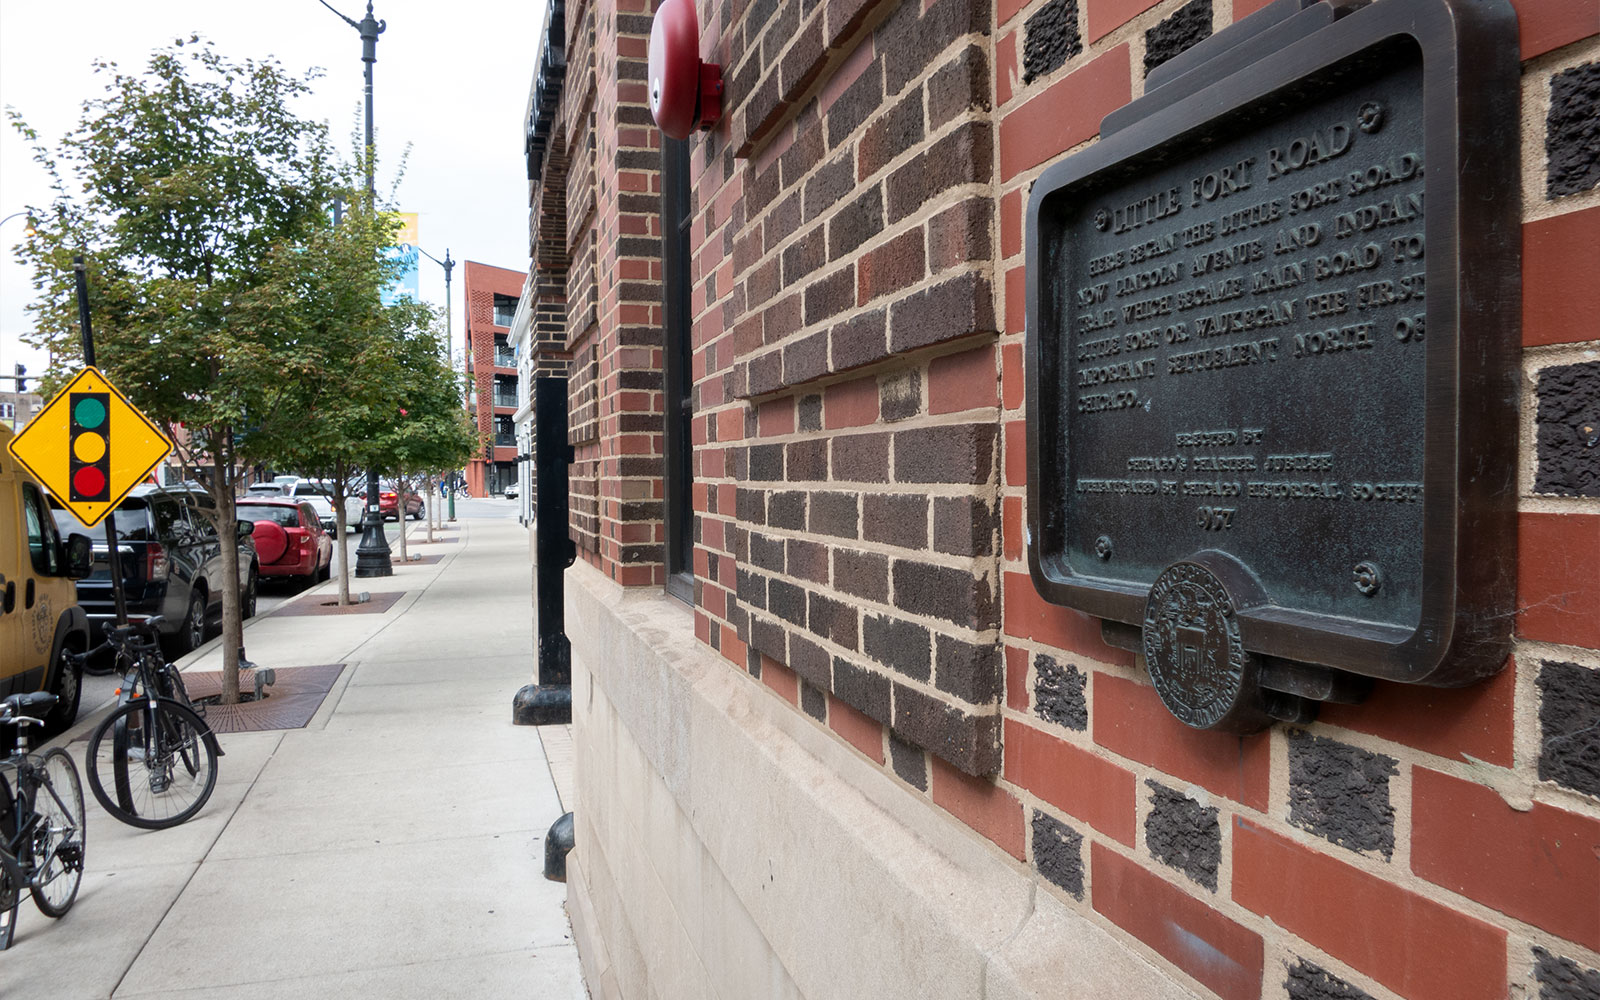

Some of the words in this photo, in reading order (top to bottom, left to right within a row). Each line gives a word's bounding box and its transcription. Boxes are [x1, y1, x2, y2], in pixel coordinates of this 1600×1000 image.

[1113, 187, 1182, 234] LITTLE
[1191, 157, 1256, 207] FORT
[1266, 122, 1350, 181] ROAD
[1077, 281, 1109, 307] NOW
[1116, 261, 1184, 297] LINCOLN
[1191, 237, 1264, 278] AVENUE
[1273, 223, 1321, 256] AND
[1335, 190, 1424, 240] INDIAN
[1089, 250, 1125, 277] HERE
[1129, 232, 1182, 264] BEGAN
[1182, 221, 1216, 248] THE
[1220, 199, 1282, 235] LITTLE
[1289, 177, 1342, 215] FORT
[1077, 335, 1121, 361] LITTLE
[1124, 327, 1161, 352] FORT
[1164, 322, 1190, 345] OR
[1195, 299, 1298, 339] WAUKEGAN
[1305, 290, 1349, 319] THE
[1356, 272, 1425, 310] FIRST
[1078, 308, 1116, 333] TRAIL
[1121, 293, 1173, 324] WHICH
[1176, 276, 1246, 311] BECAME
[1251, 258, 1309, 295] MAIN
[1315, 241, 1382, 281] ROAD
[1390, 233, 1424, 263] TO
[1077, 357, 1156, 387] IMPORTANT
[1167, 338, 1280, 374] SETTLEMENT
[1293, 321, 1376, 358] NORTH
[1077, 389, 1142, 414] CHICAGO.
[1176, 430, 1238, 447] ERECTED
[1242, 428, 1264, 445] BY
[1127, 453, 1187, 472] CHICAGO'S
[1193, 455, 1256, 472] CHARTER
[1264, 453, 1334, 472] JUBILEE
[1161, 480, 1179, 496] BY
[1183, 481, 1242, 497] CHICAGO
[1247, 481, 1343, 500] HISTORICAL
